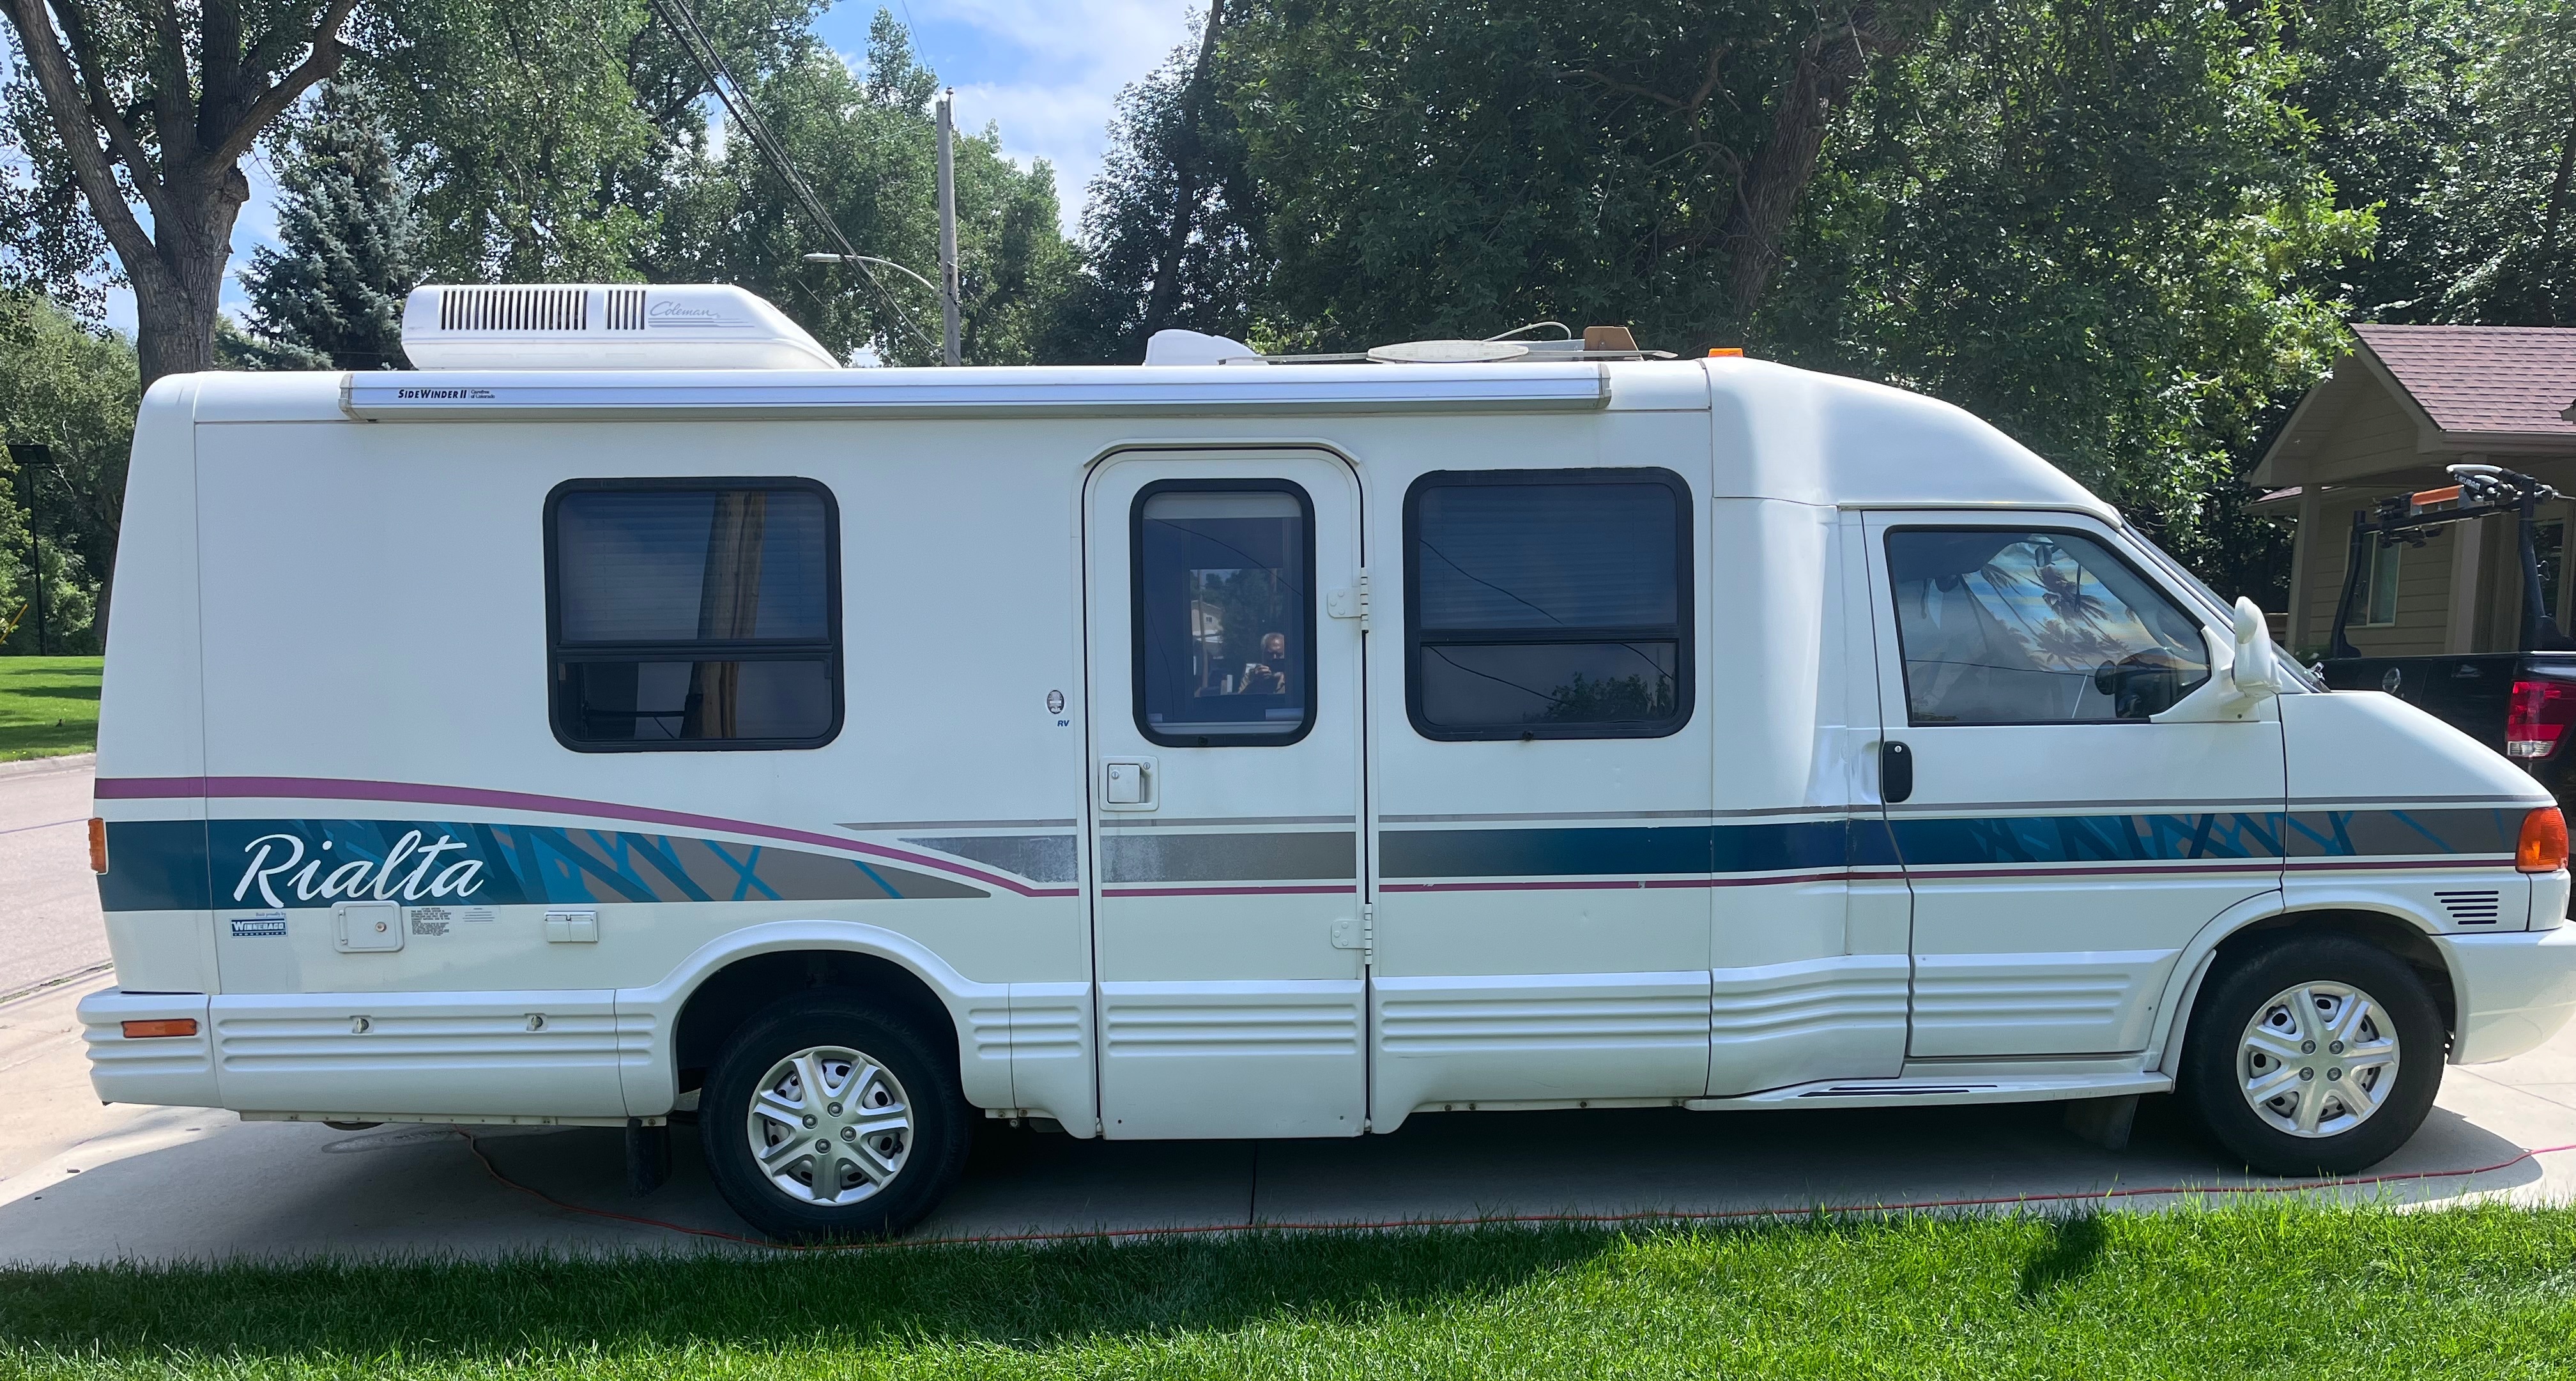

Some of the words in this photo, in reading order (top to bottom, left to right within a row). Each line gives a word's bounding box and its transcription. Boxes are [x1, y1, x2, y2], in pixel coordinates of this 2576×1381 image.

[649, 301, 717, 316] Coleman
[233, 830, 484, 908] Rialta
[231, 921, 284, 931] WINNEBAGO
